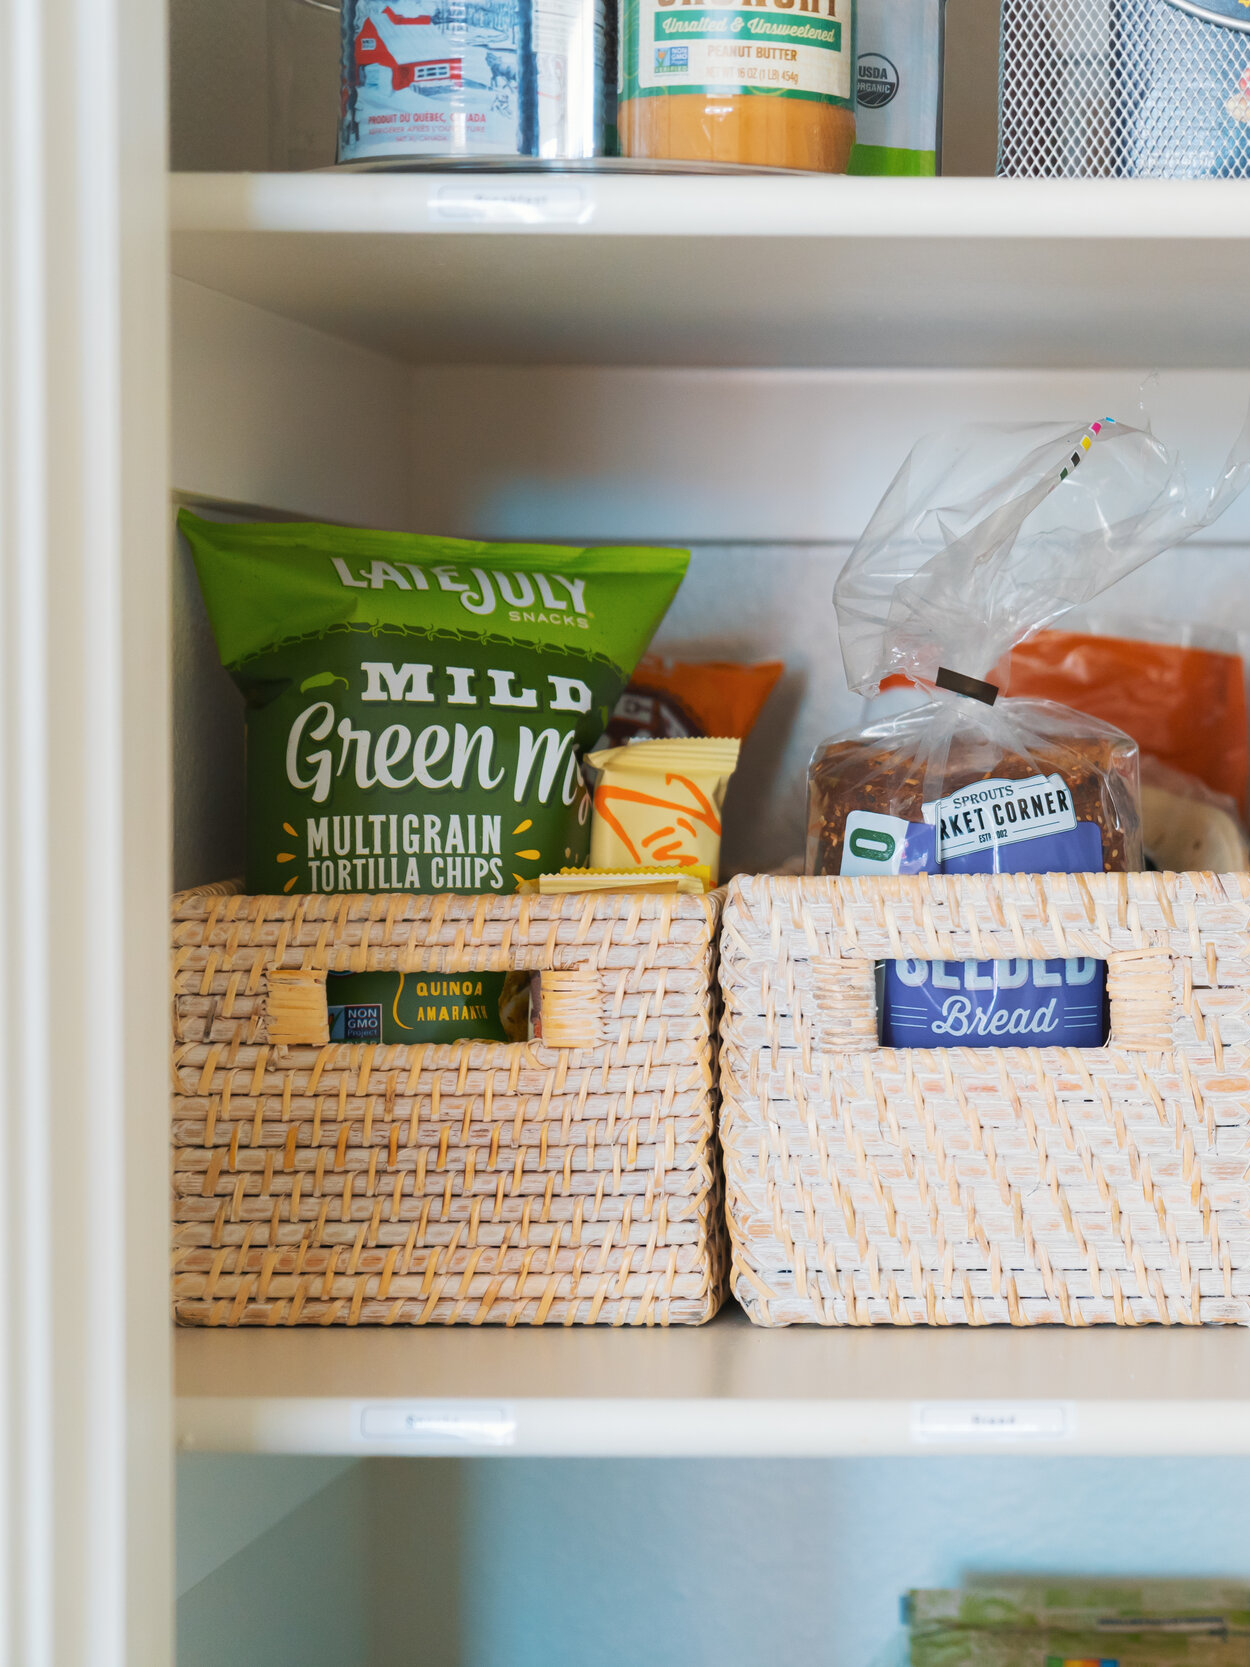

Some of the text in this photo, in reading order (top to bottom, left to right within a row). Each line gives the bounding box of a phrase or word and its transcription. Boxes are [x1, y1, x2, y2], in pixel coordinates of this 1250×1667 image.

[663, 18, 836, 43] Unsalted & Unsweetened
[708, 45, 798, 62] PEANUT BUTTER
[859, 65, 888, 80] USDA
[368, 113, 397, 124] PRODUIT
[400, 112, 411, 123] DU
[508, 610, 590, 630] SNACKS
[361, 661, 592, 715] MILD
[286, 701, 505, 804] Green
[952, 785, 1015, 811] SPROUTS
[991, 788, 1070, 827] CORNER
[307, 814, 502, 865] MULTIGRAIN
[307, 857, 505, 893] TORTILLA CHIPS
[416, 980, 484, 997] QUINOA
[348, 1008, 378, 1022] NON
[416, 1004, 489, 1022] AMARANTH
[930, 994, 1060, 1037] Bread
[347, 1020, 379, 1030] GMO
